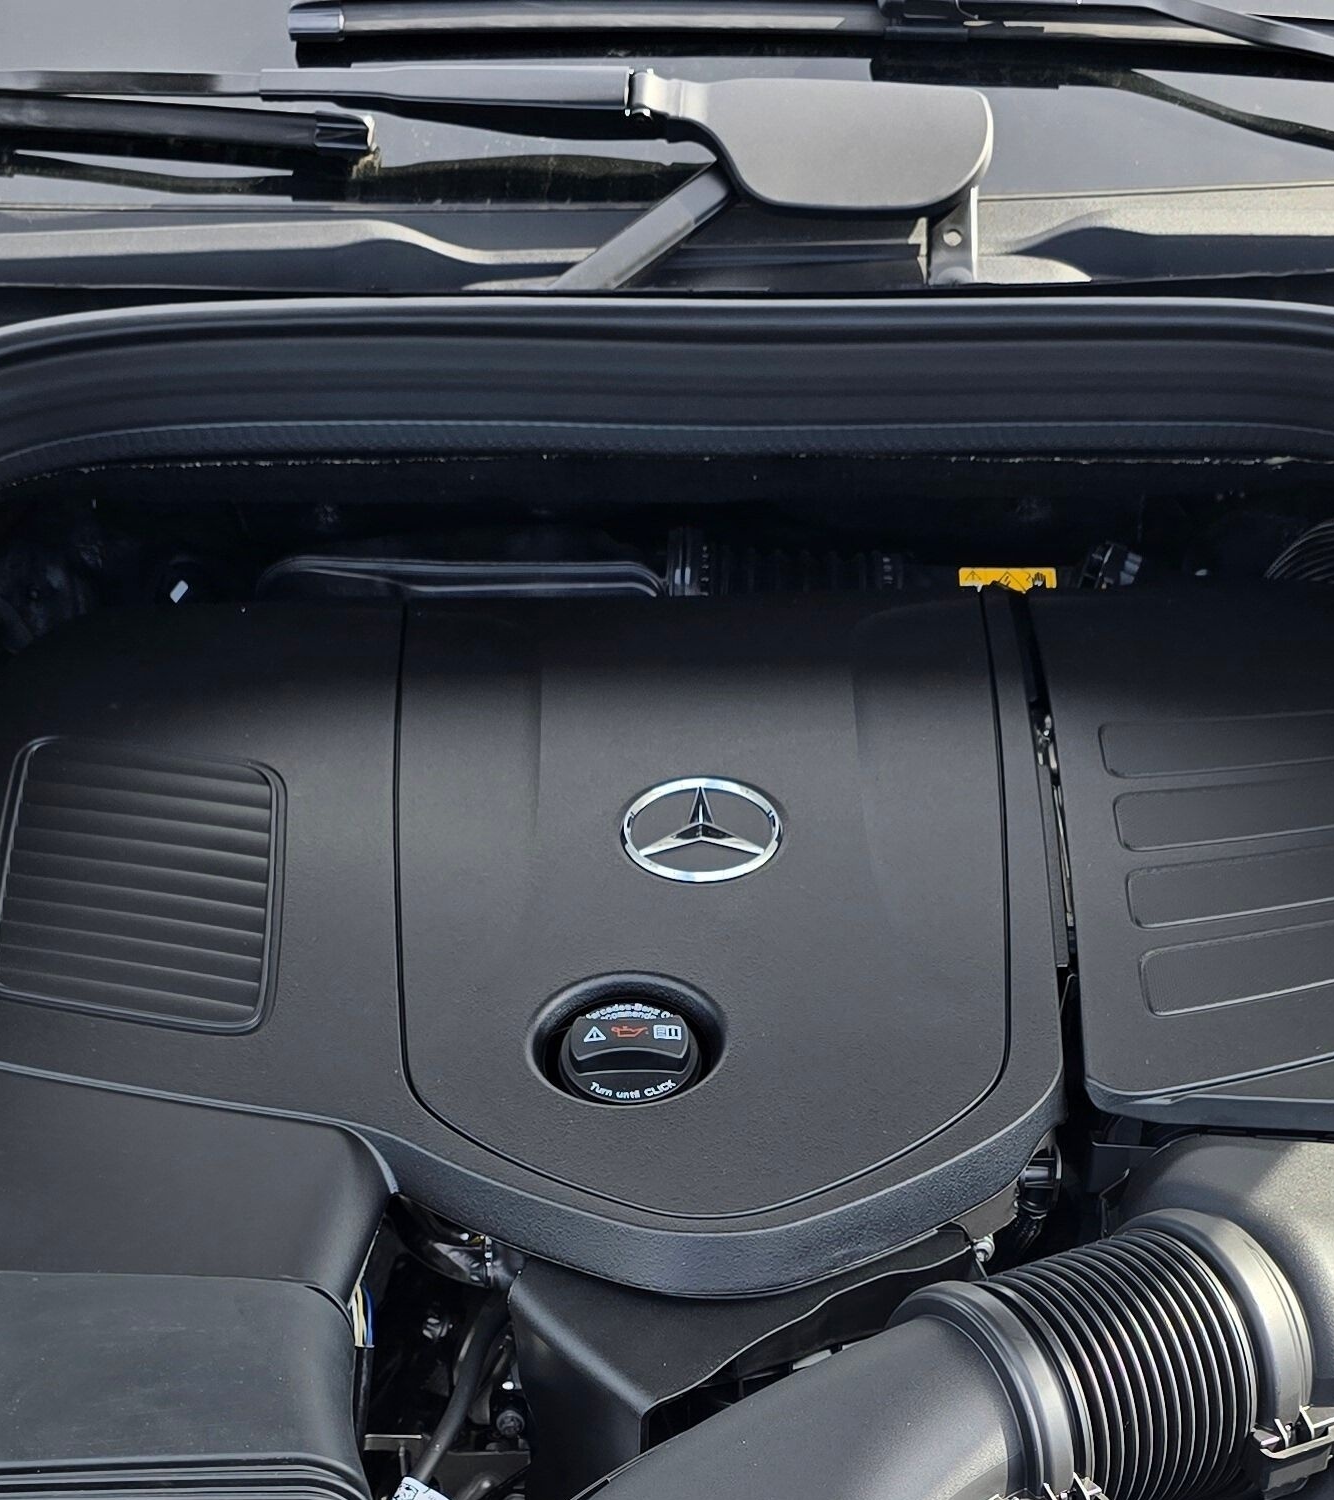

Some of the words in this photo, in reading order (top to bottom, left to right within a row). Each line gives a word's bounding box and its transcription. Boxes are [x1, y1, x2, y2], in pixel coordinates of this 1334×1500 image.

[590, 1081, 612, 1097] Turn
[615, 1089, 640, 1099] until
[643, 1079, 676, 1097] CLICK
